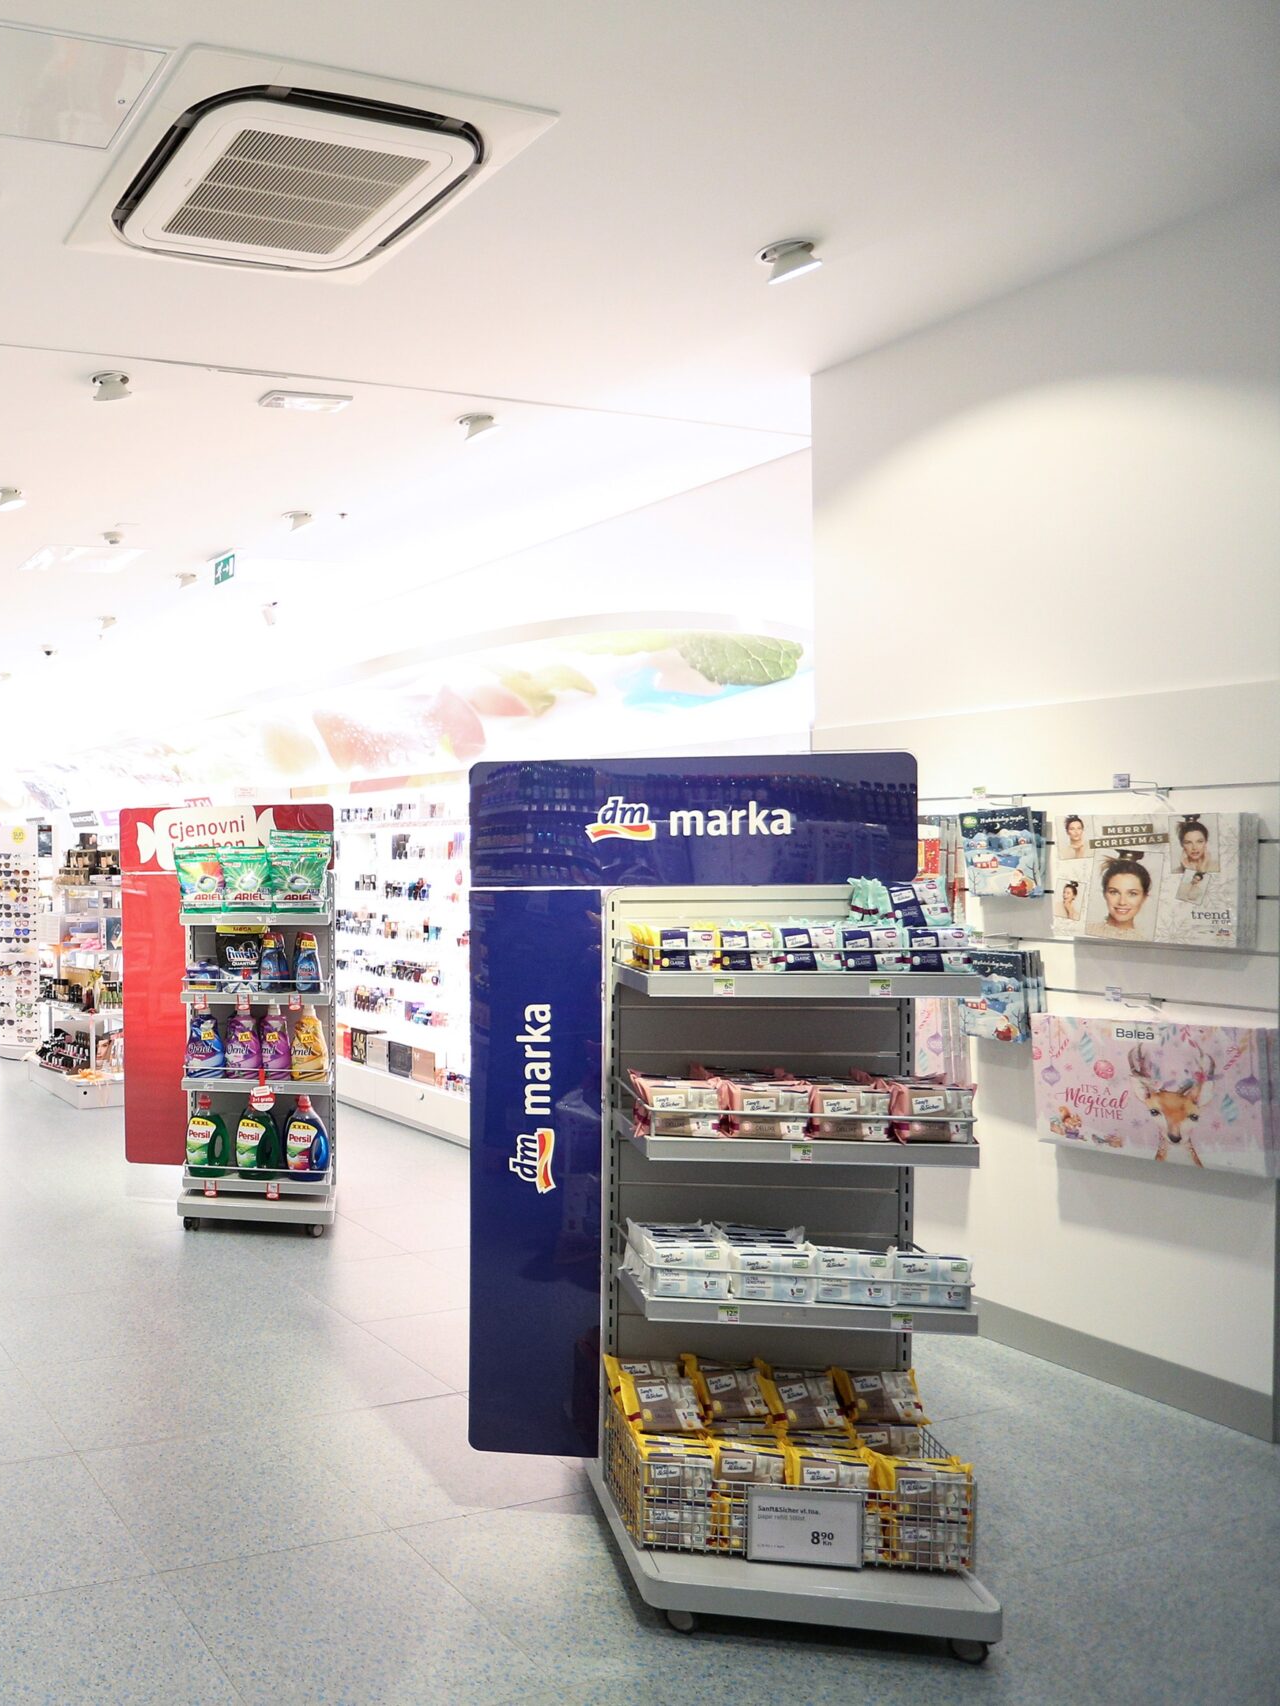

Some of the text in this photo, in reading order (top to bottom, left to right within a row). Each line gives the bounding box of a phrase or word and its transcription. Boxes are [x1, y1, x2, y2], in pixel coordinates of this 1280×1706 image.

[668, 800, 793, 838] marka
[168, 815, 245, 842] Cjenovni
[1107, 825, 1148, 834] MERRY
[1094, 835, 1164, 848] CHRISTMAS
[234, 892, 265, 900] ARIEL
[1191, 909, 1231, 920] trend
[227, 946, 258, 960] finish
[1115, 1027, 1156, 1041] Balea
[261, 1044, 276, 1054] rnel
[516, 1003, 551, 1115] marka
[1103, 1087, 1112, 1096] A
[1065, 1087, 1129, 1116] Magical
[1092, 1107, 1123, 1120] TIME
[188, 1129, 210, 1139] Persil
[238, 1131, 260, 1141] Persil
[288, 1133, 312, 1143] Persil
